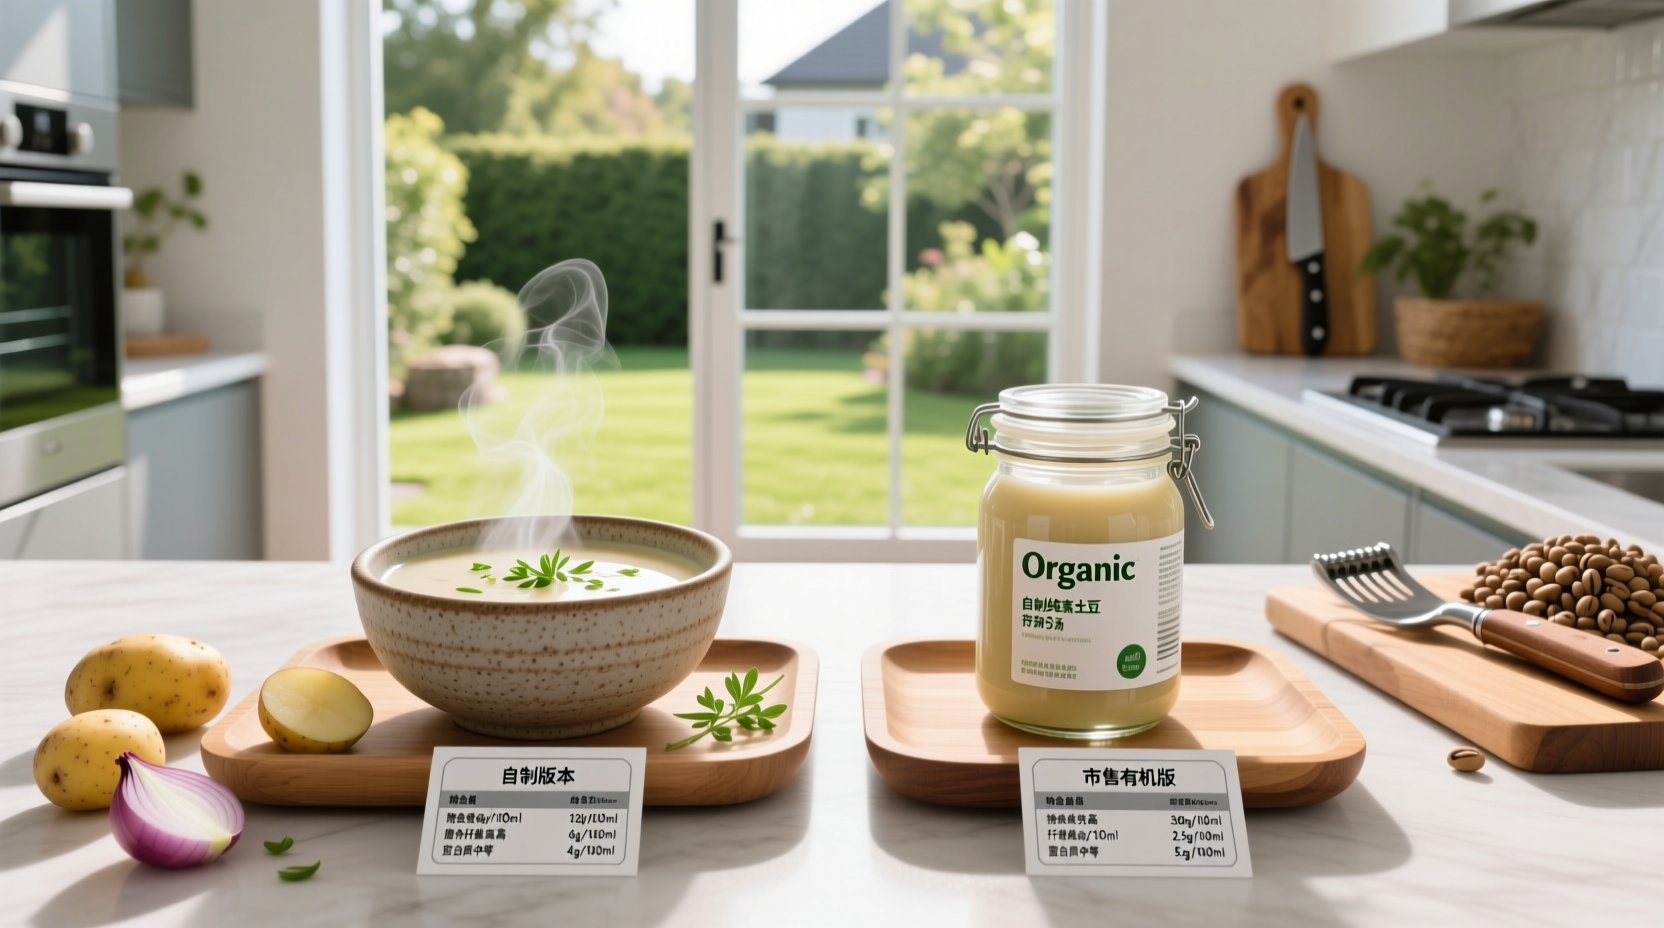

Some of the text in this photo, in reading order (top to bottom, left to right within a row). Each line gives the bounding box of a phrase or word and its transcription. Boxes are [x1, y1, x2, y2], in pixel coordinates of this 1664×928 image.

[1022, 551, 1136, 590] Organic
[502, 766, 575, 785] 自制版本
[1082, 767, 1176, 787] 市售有机版
